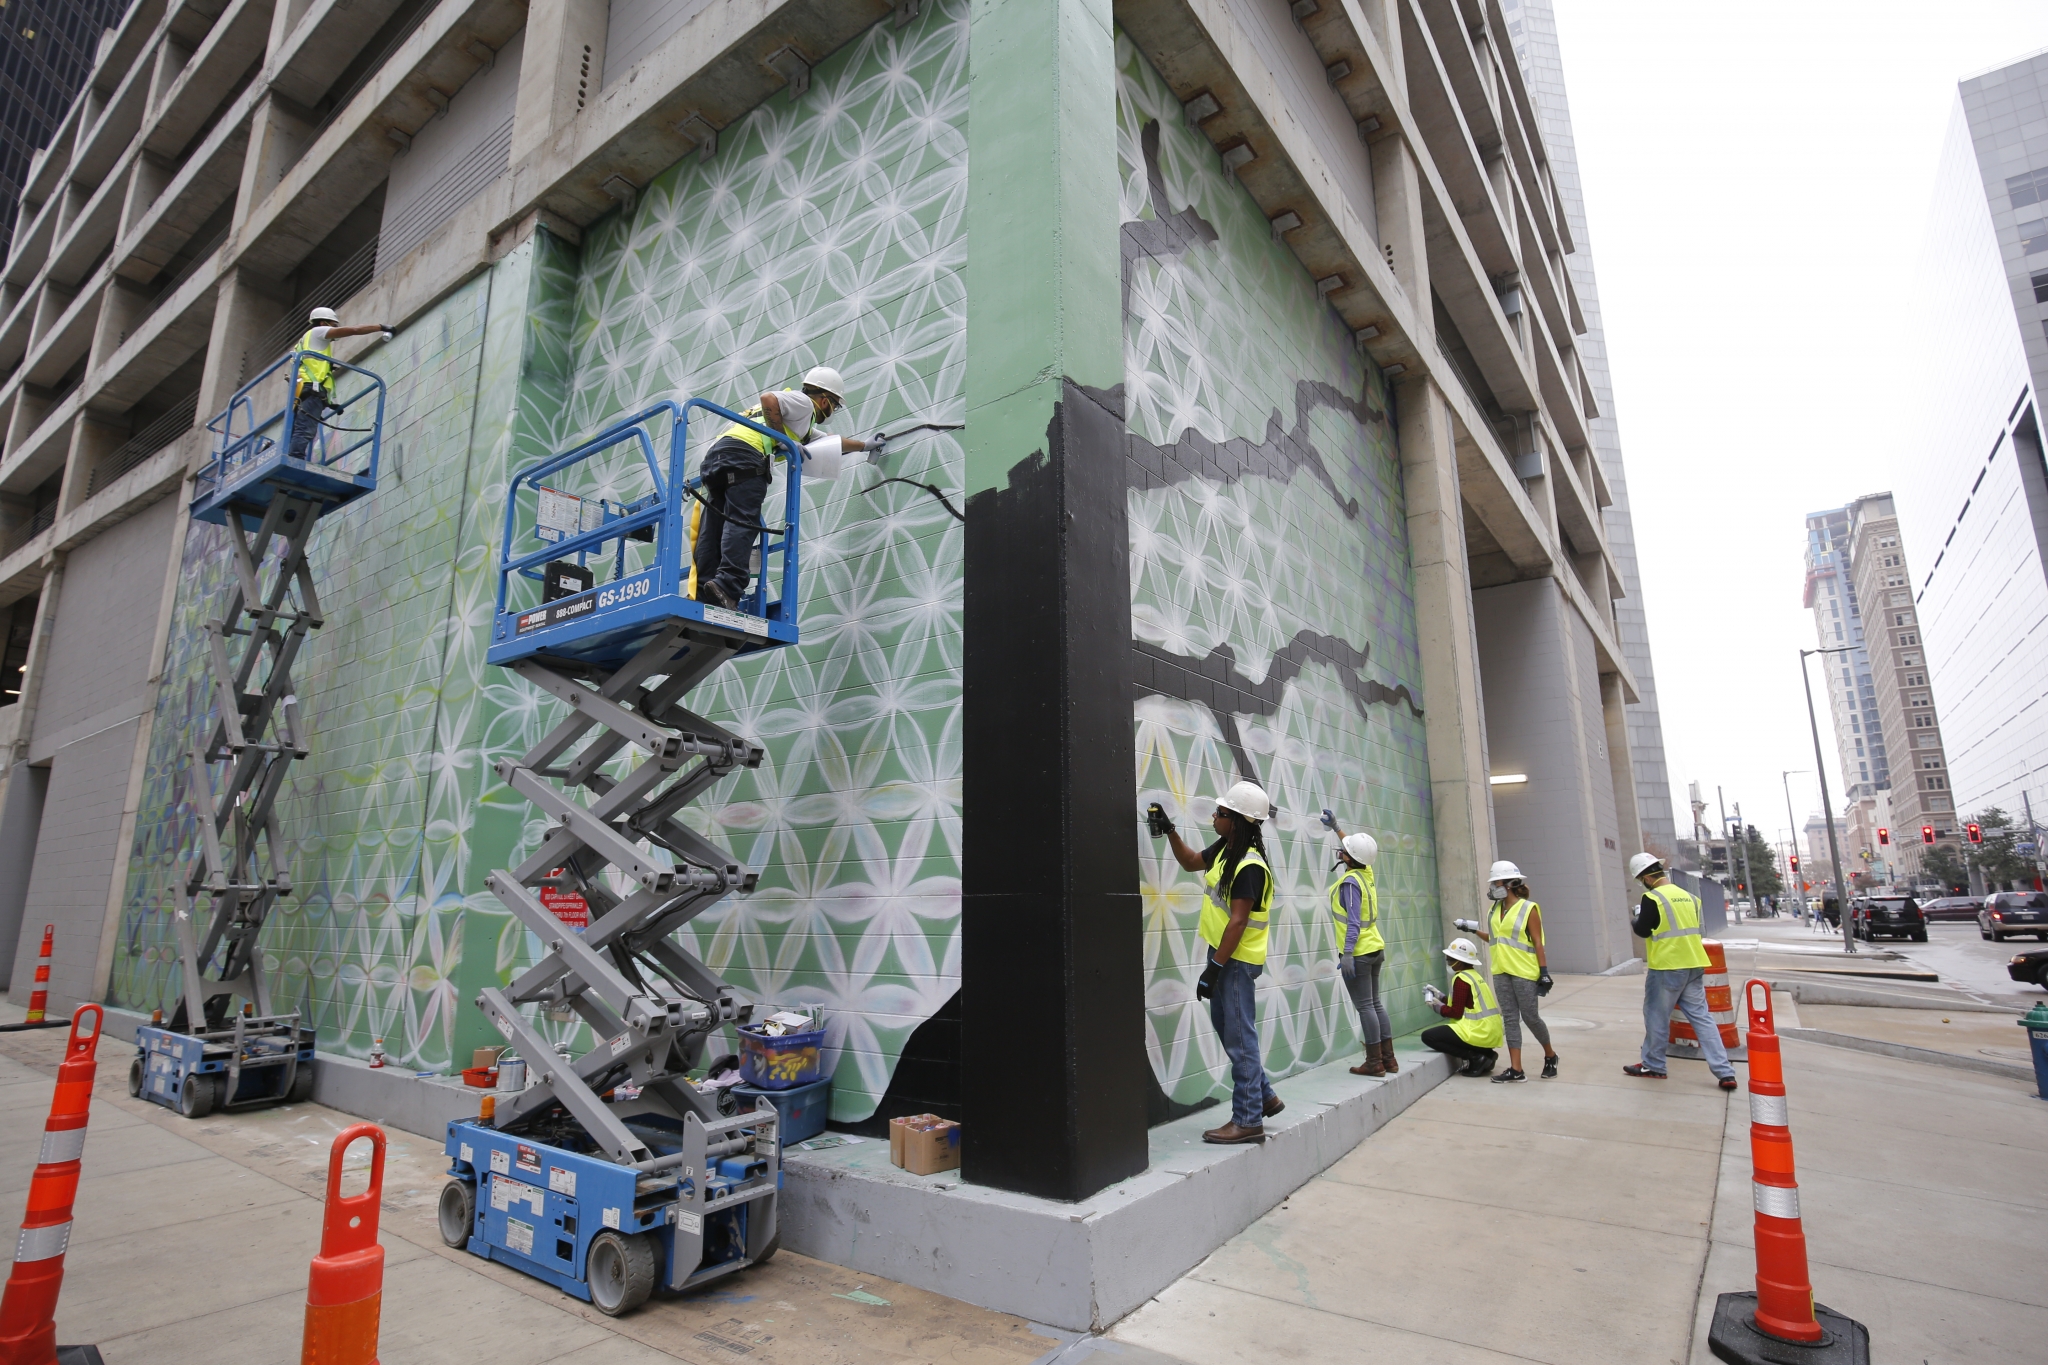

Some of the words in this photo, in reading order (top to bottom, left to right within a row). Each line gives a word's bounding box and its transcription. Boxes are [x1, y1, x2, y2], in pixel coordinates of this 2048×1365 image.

[598, 578, 650, 608] GS-1930
[528, 610, 547, 625] POWER
[556, 599, 593, 619] 888-COMPACT
